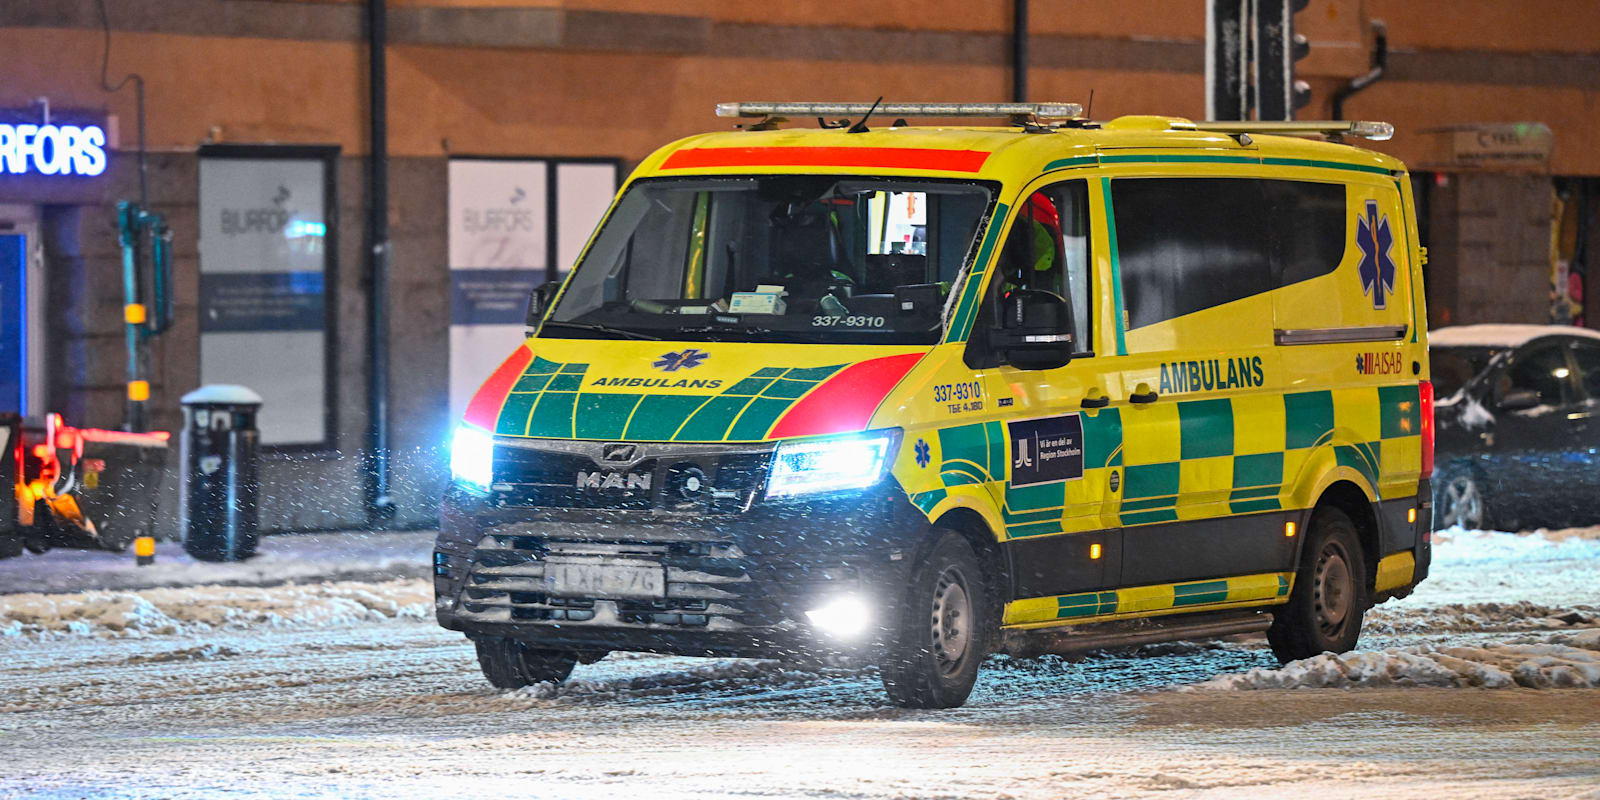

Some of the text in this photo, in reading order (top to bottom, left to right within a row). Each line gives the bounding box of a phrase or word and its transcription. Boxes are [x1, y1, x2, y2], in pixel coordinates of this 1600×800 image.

[812, 315, 885, 328] 337-9310
[1373, 351, 1402, 375] AISAB
[1159, 355, 1264, 394] AMBULANS
[591, 377, 723, 389] AMBULANS
[933, 381, 981, 403] 337-9310
[1040, 440, 1046, 449] Vi
[1046, 438, 1052, 448] är
[1052, 439, 1058, 447] en
[1058, 437, 1066, 446] del
[1040, 448, 1081, 461] Region Stockholm
[576, 471, 652, 490] MAN
